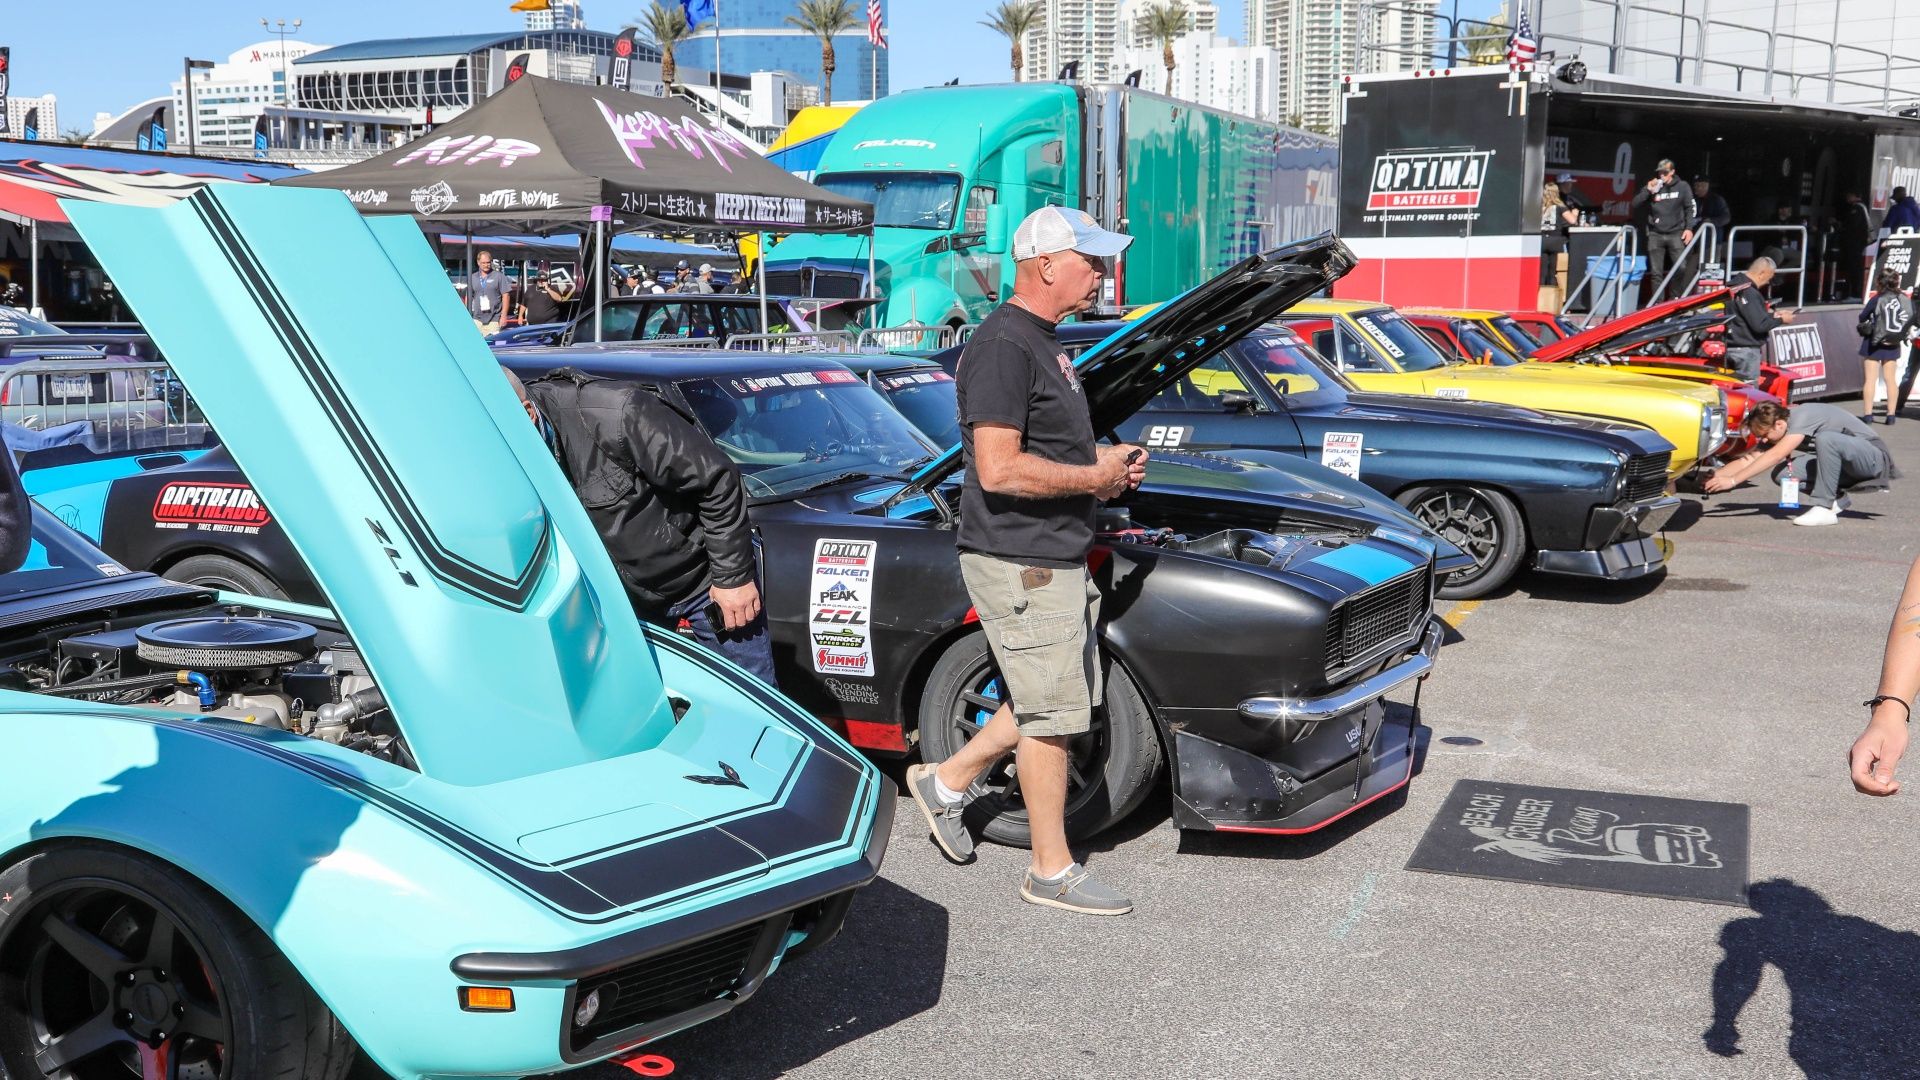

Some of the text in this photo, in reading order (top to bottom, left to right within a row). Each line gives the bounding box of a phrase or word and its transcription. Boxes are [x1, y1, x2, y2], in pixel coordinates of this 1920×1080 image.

[262, 49, 307, 59] MARRIOTT
[1376, 159, 1480, 190] OPTIMA
[410, 194, 459, 204] DRIFT SCHOOL
[479, 189, 564, 210] BATTLE ROYALE
[1392, 194, 1458, 206] BATTERIES
[1363, 212, 1480, 223] THE ULTIMATE POWER SOURCE
[1888, 247, 1912, 255] SCAN
[1886, 254, 1910, 263] SPIN
[1775, 330, 1821, 362] OPTIMA
[1147, 425, 1184, 447] 99
[1327, 461, 1352, 469] PEAK
[197, 523, 212, 532] TIRES,
[212, 523, 233, 533] WHEELS
[233, 525, 244, 534] AND
[244, 526, 260, 535] MORE
[364, 517, 419, 588] ZL1
[821, 543, 869, 558] OPTIMA
[816, 567, 870, 577] FALKEN
[820, 590, 859, 604] PEAK
[813, 608, 867, 625] CCL
[813, 634, 863, 644] WYNROCK
[842, 682, 873, 692] OCEAN
[840, 688, 879, 700] VENDING
[840, 694, 879, 705] SERVICES
[1459, 793, 1505, 828] BEACH
[1505, 798, 1554, 841] CRUISER
[1546, 806, 1620, 847] Racing
